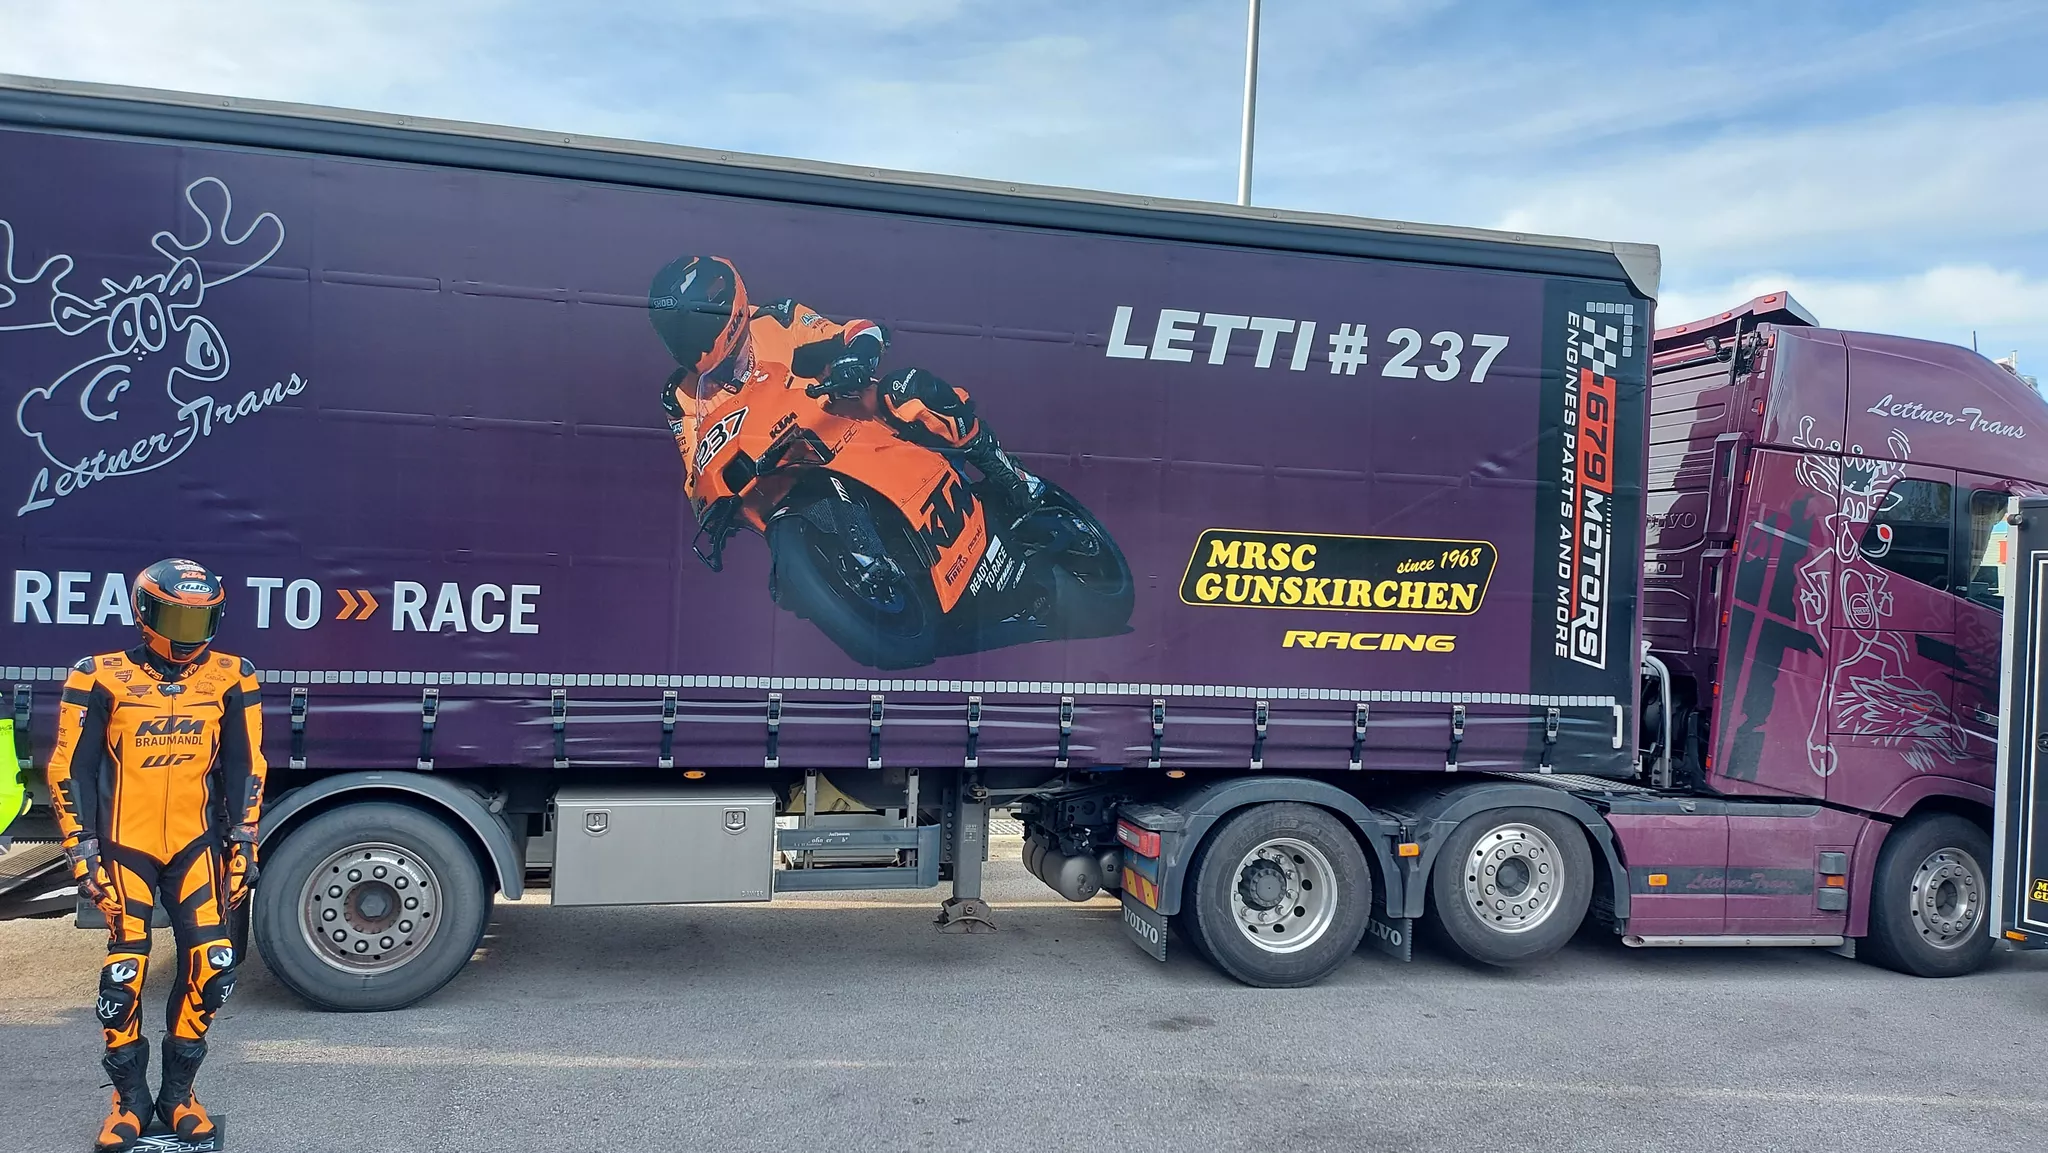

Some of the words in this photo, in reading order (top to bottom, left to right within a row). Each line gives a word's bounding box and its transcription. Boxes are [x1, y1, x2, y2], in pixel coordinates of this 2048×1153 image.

[1106, 306, 1317, 372] LETTI
[1328, 323, 1369, 375] #
[1382, 328, 1510, 384] 237
[1563, 311, 1580, 427] ENGINES
[697, 407, 748, 473] 237
[769, 411, 799, 440] KTM
[1583, 391, 1610, 484] 679
[1866, 394, 2026, 440] Lettner-Trans
[18, 373, 308, 517] Lettner-Trans
[1560, 432, 1576, 518] PARTS
[917, 470, 977, 548] KTM
[991, 545, 1008, 577] RACE
[1206, 538, 1318, 573] MRSC
[1396, 556, 1435, 574] since
[1440, 548, 1483, 570] 1968
[1558, 524, 1572, 580] AND
[1578, 489, 1604, 658] MOTORS
[180, 583, 208, 593] HJC
[969, 559, 990, 597] READY
[1195, 573, 1479, 611] GUNSKIRCHEN
[246, 576, 322, 630] TO
[392, 580, 542, 635] RACE
[1555, 585, 1570, 659] MORE
[1282, 630, 1458, 653] RACING
[134, 715, 206, 737] KTM
[134, 736, 204, 748] BRAUMANDL
[1123, 904, 1159, 945] VOLVO
[1370, 918, 1402, 947] LVO
